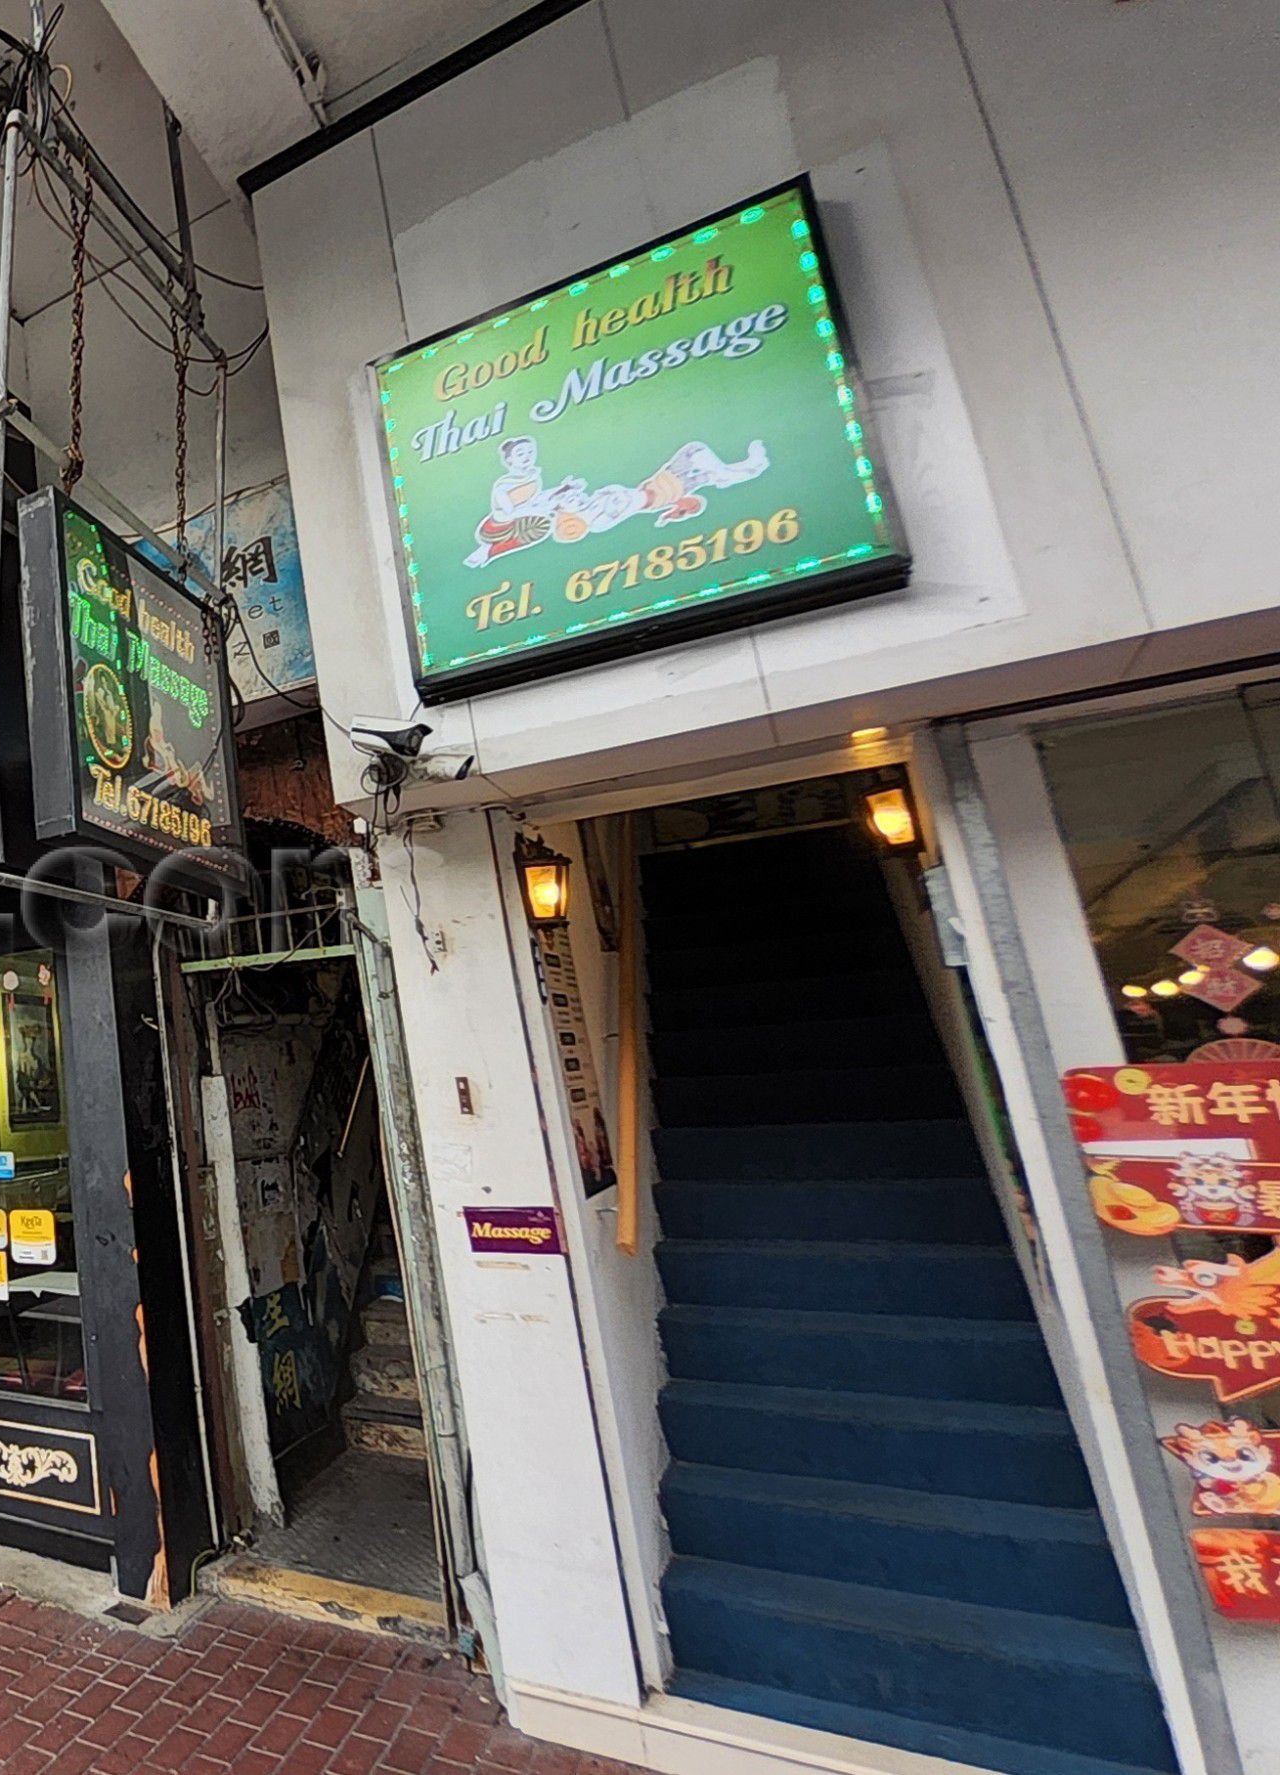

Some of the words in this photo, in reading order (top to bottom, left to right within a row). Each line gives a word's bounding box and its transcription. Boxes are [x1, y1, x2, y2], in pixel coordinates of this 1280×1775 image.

[412, 403, 505, 462] Thai
[530, 303, 789, 423] Massage
[434, 325, 549, 402] Good
[571, 254, 734, 350] health
[77, 558, 132, 622] Good
[138, 599, 195, 664] health
[466, 582, 540, 632] Tel.
[565, 509, 799, 603] 67185196
[68, 589, 118, 661] Thai
[126, 627, 208, 729] Massage
[1147, 1079, 1280, 1126] 新年
[471, 1222, 552, 1244] Massage
